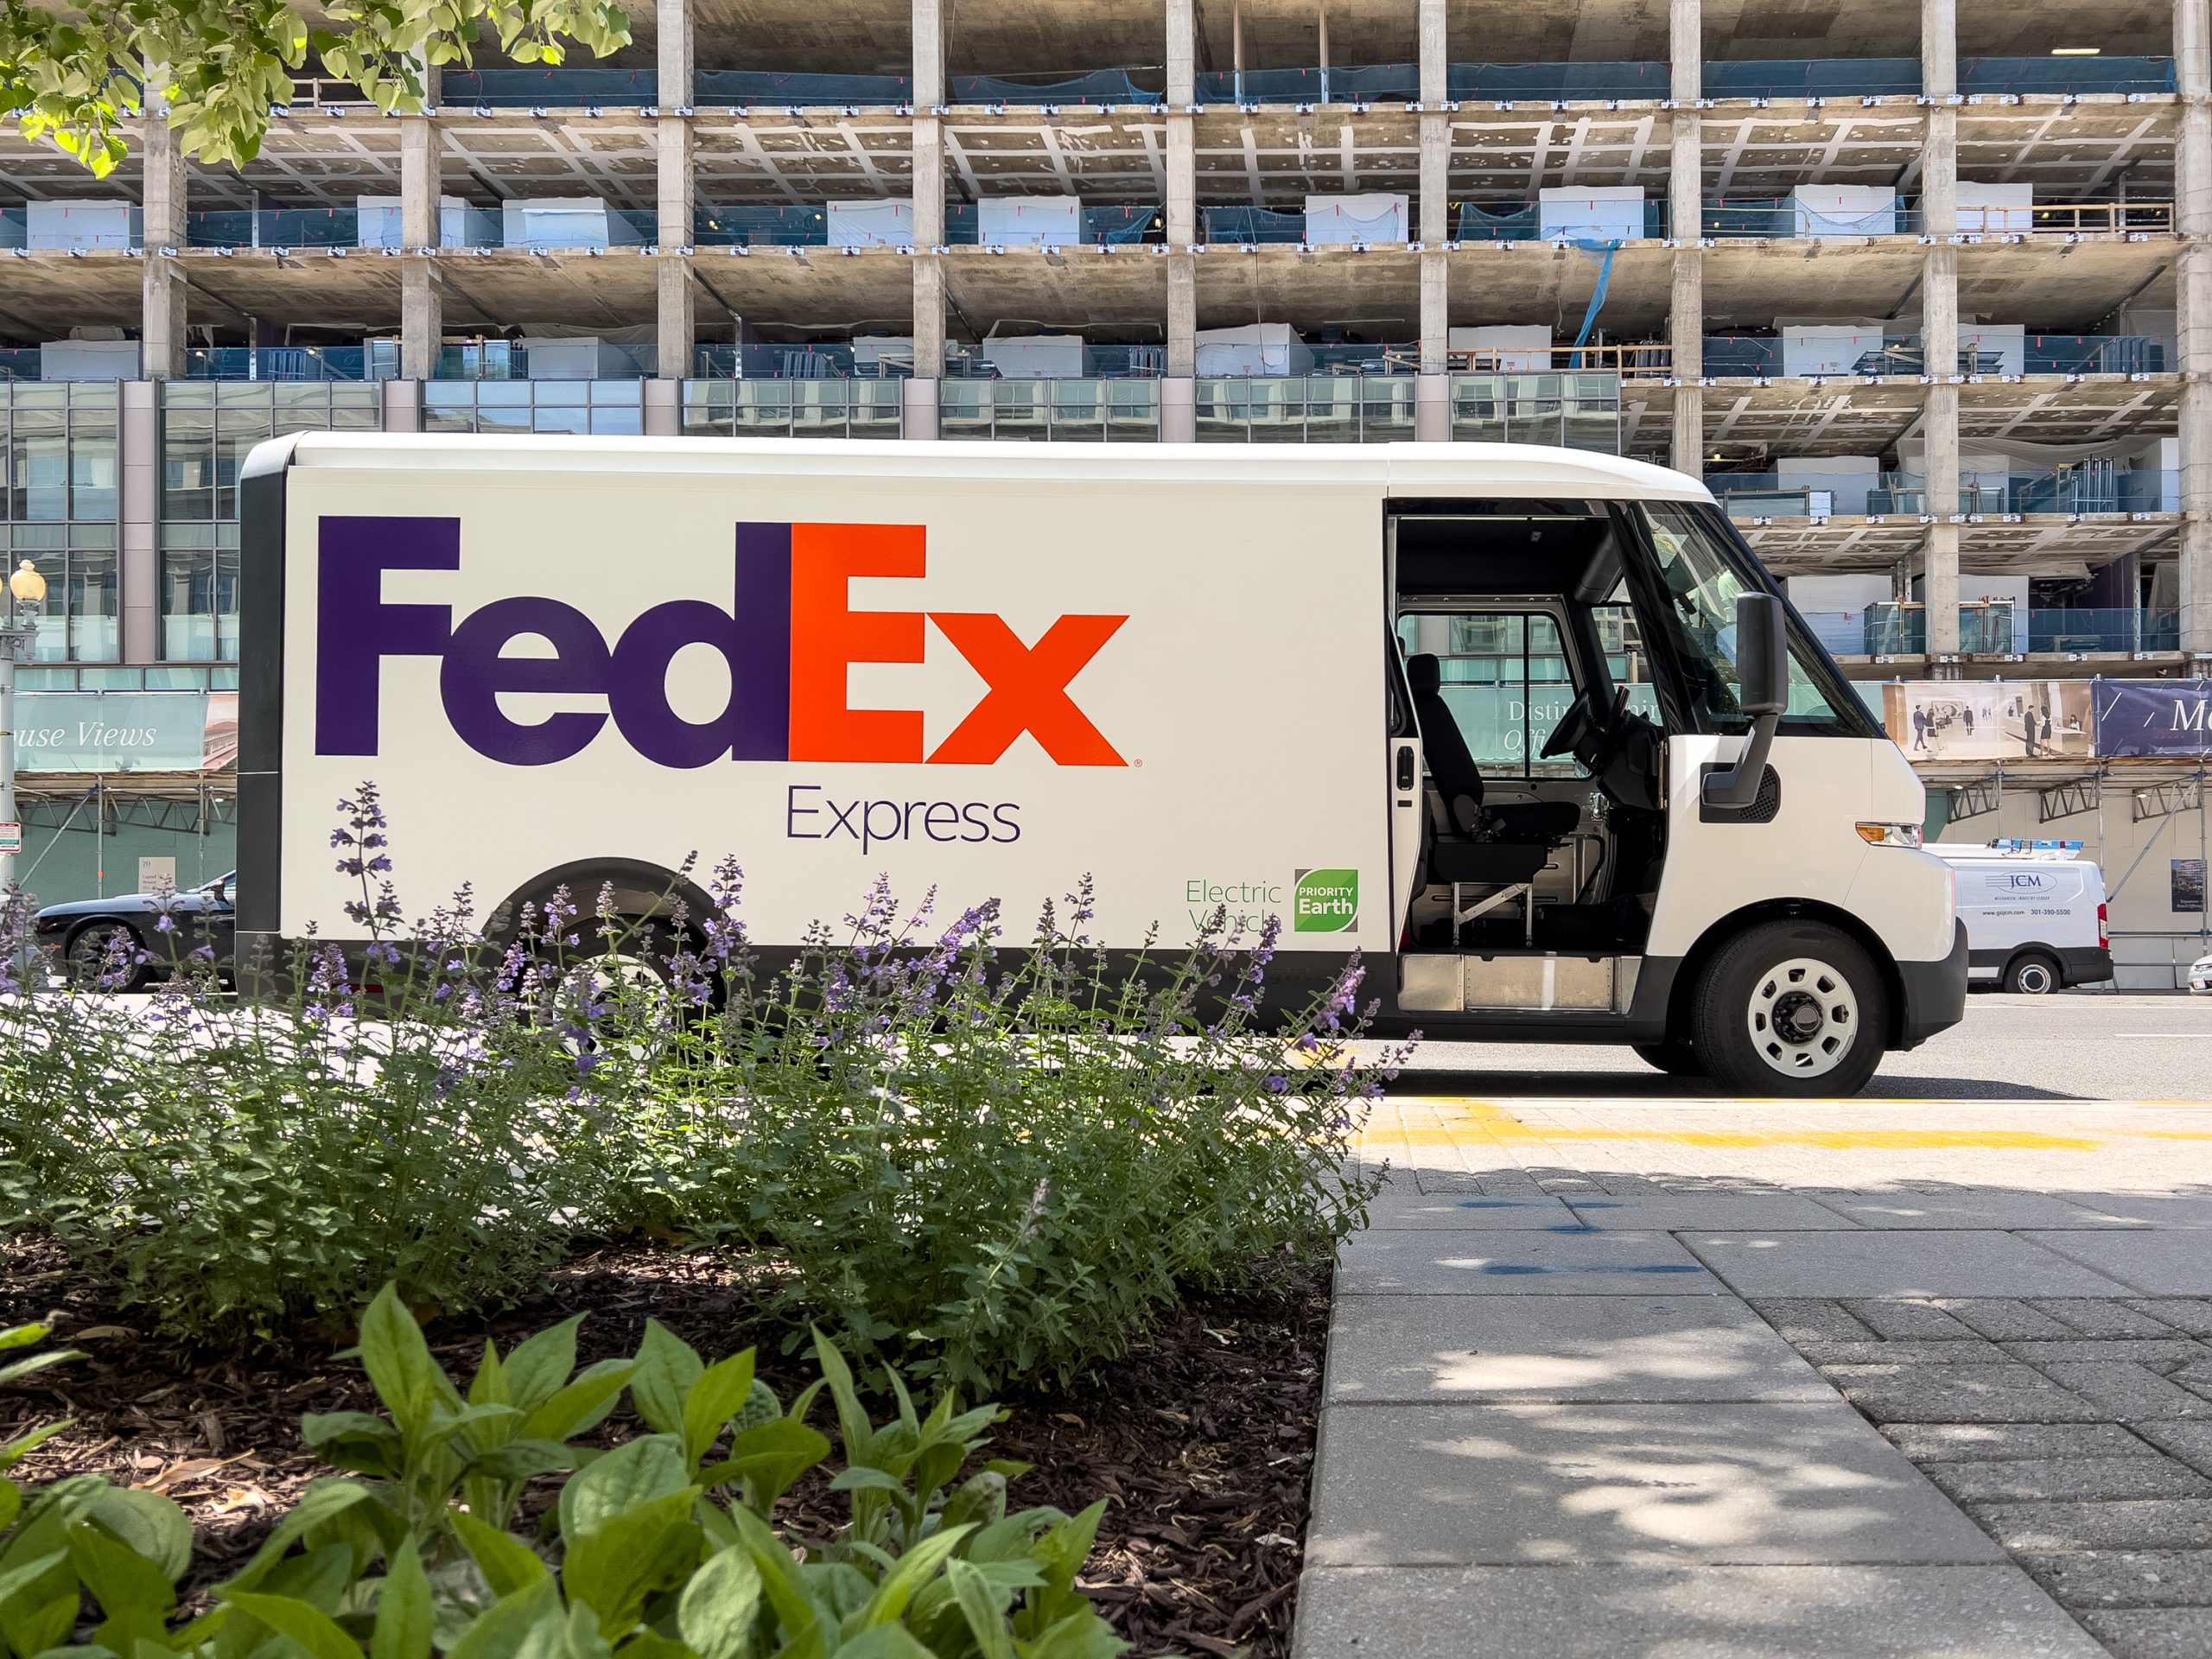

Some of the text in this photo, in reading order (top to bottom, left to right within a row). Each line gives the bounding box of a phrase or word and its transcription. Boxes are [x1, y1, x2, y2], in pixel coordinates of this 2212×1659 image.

[315, 516, 1130, 769] FedEx
[2170, 699, 2212, 732] M
[77, 721, 157, 747] Views
[788, 785, 1020, 855] Express
[1186, 880, 1282, 904] Electric
[1299, 887, 1354, 897] PRIORITY
[2010, 874, 2042, 890] JCM
[1299, 898, 1354, 915] Earth
